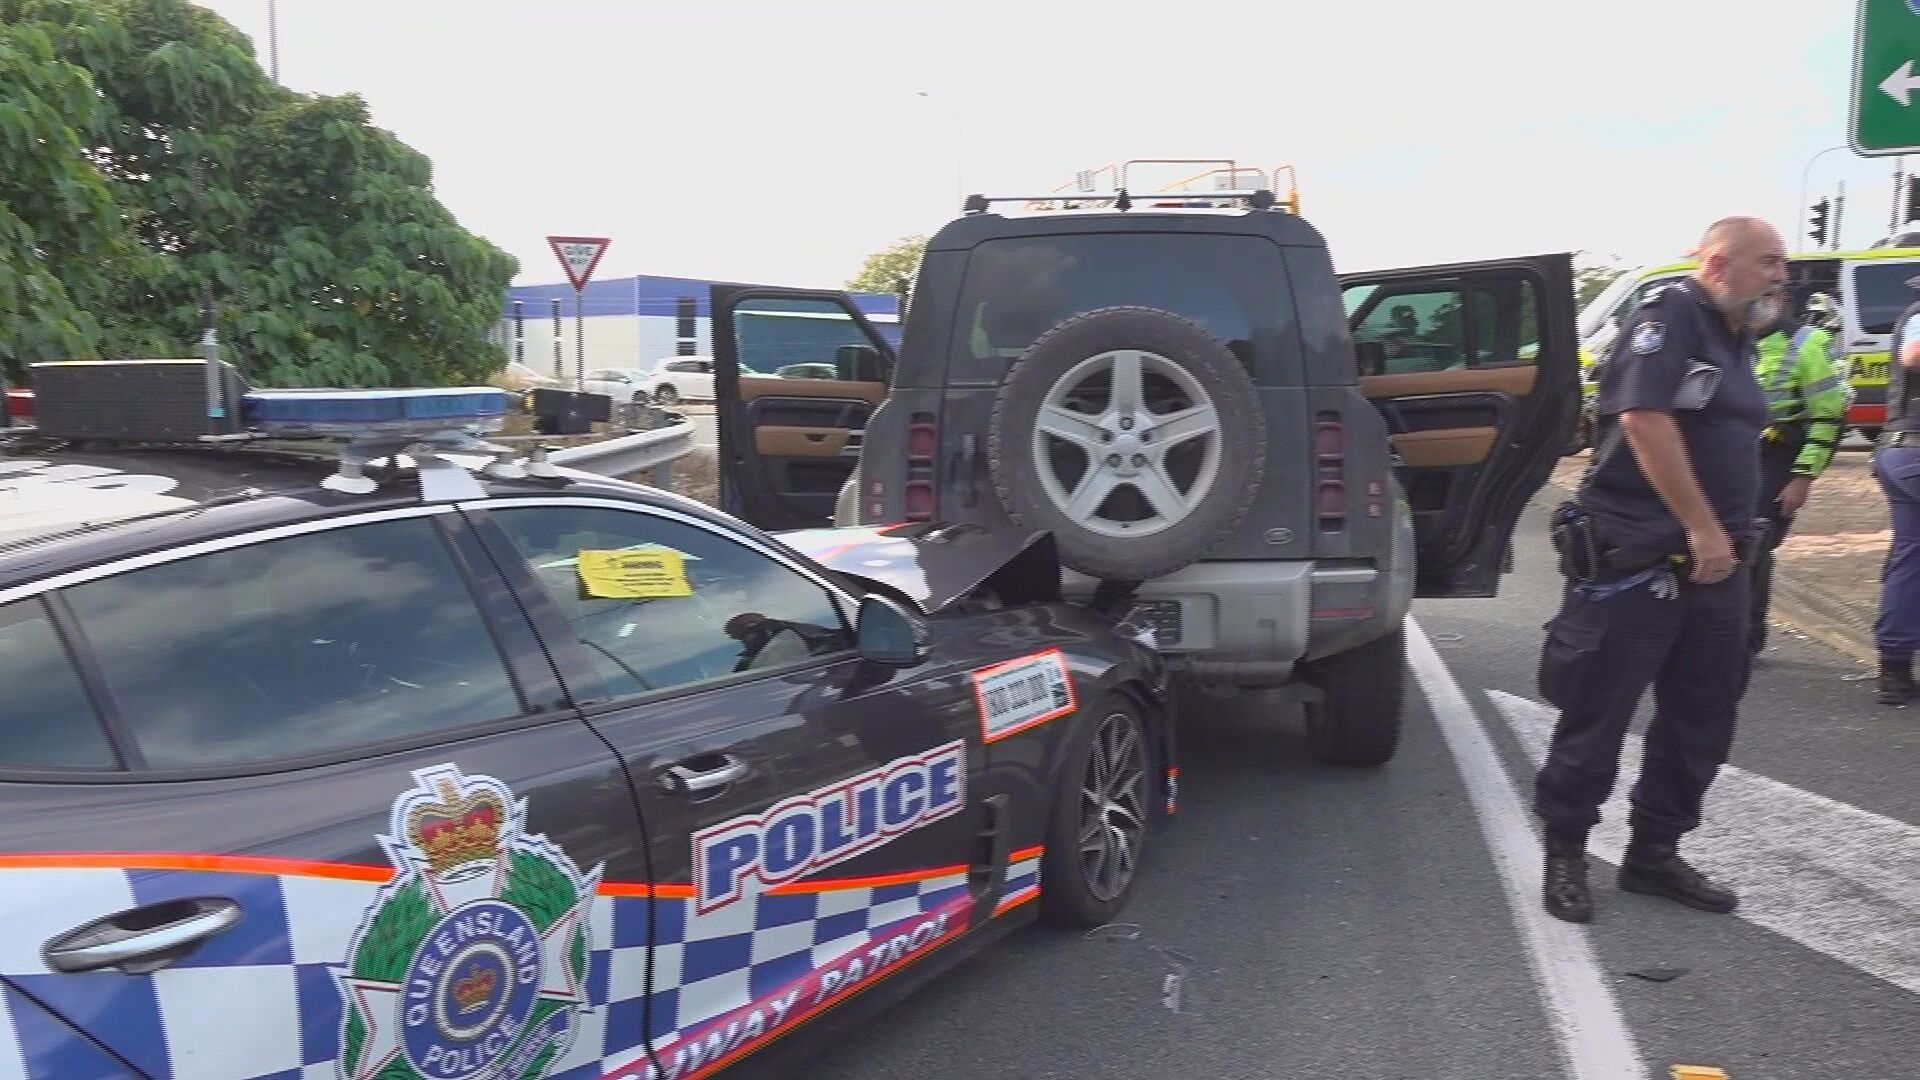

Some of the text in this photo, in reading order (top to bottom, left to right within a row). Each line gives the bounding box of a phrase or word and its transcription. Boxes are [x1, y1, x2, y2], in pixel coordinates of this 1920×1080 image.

[563, 246, 595, 256] GIVE
[568, 258, 589, 266] WAY
[702, 754, 961, 902] POLICE
[405, 910, 538, 1027] QUEENSLAND
[811, 912, 950, 1006] PATROL
[420, 1012, 520, 1075] POLICE
[507, 1022, 554, 1075] SERVE
